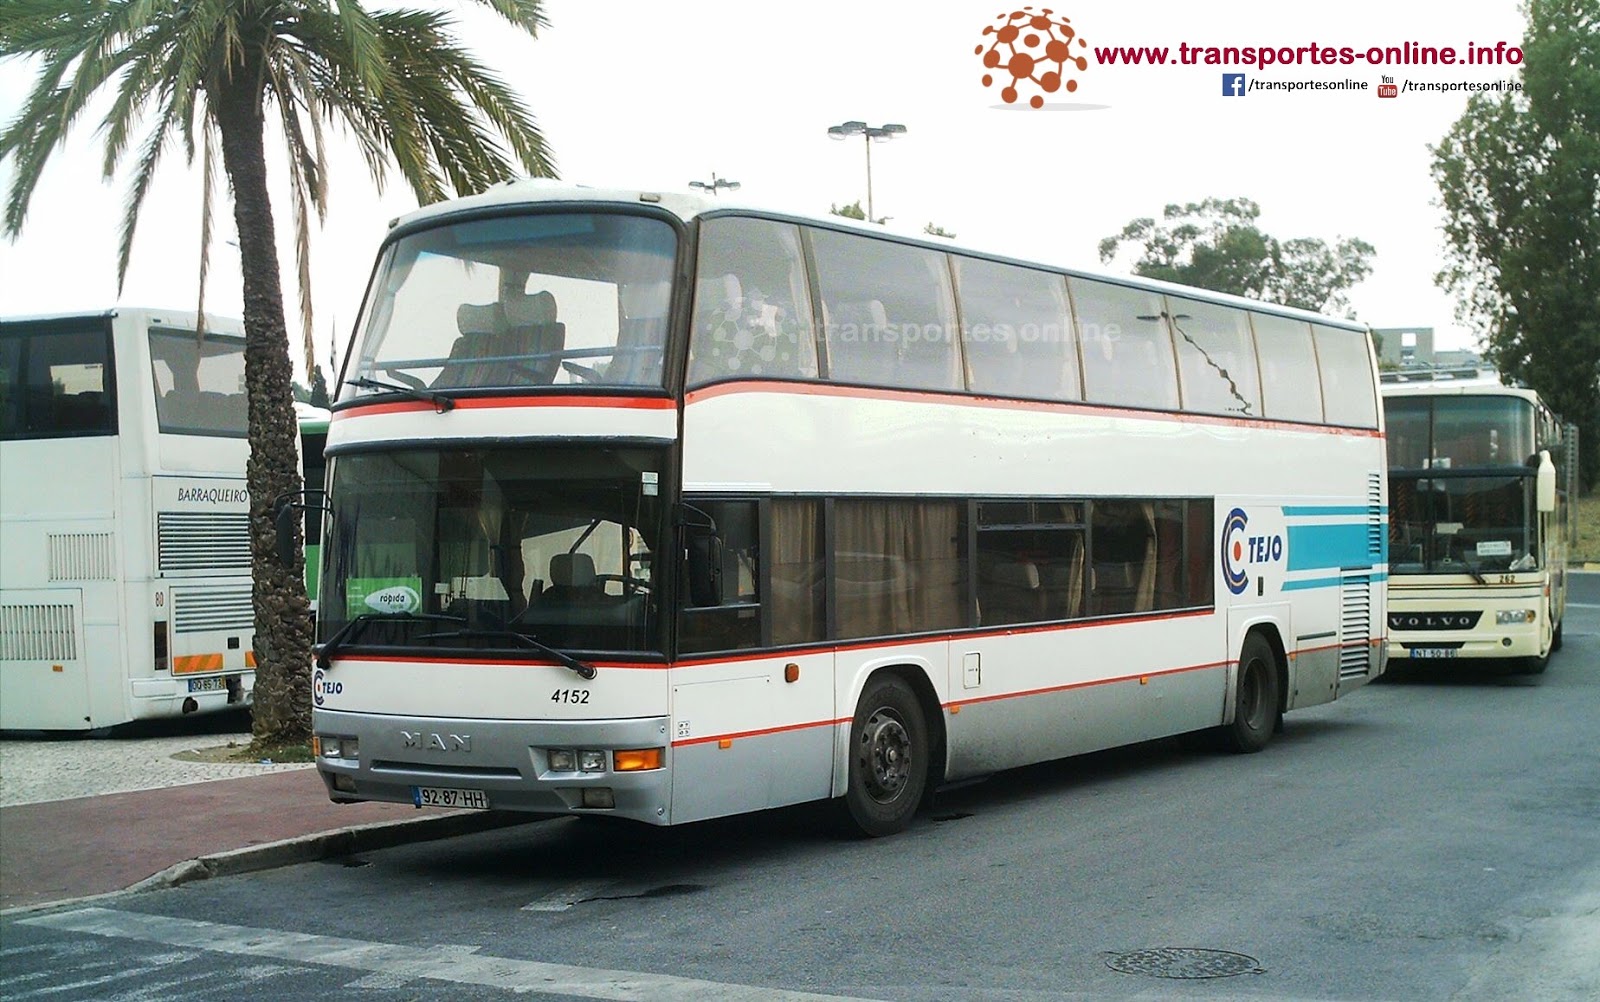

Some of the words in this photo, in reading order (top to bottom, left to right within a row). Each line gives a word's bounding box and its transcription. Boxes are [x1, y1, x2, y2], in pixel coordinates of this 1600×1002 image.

[177, 488, 247, 504] BARRAQUEIRO
[1248, 535, 1282, 563] TEJO
[1391, 616, 1470, 626] VOLVO
[322, 682, 343, 694] TEJO
[551, 689, 590, 704] 4152
[401, 730, 471, 752] MAN
